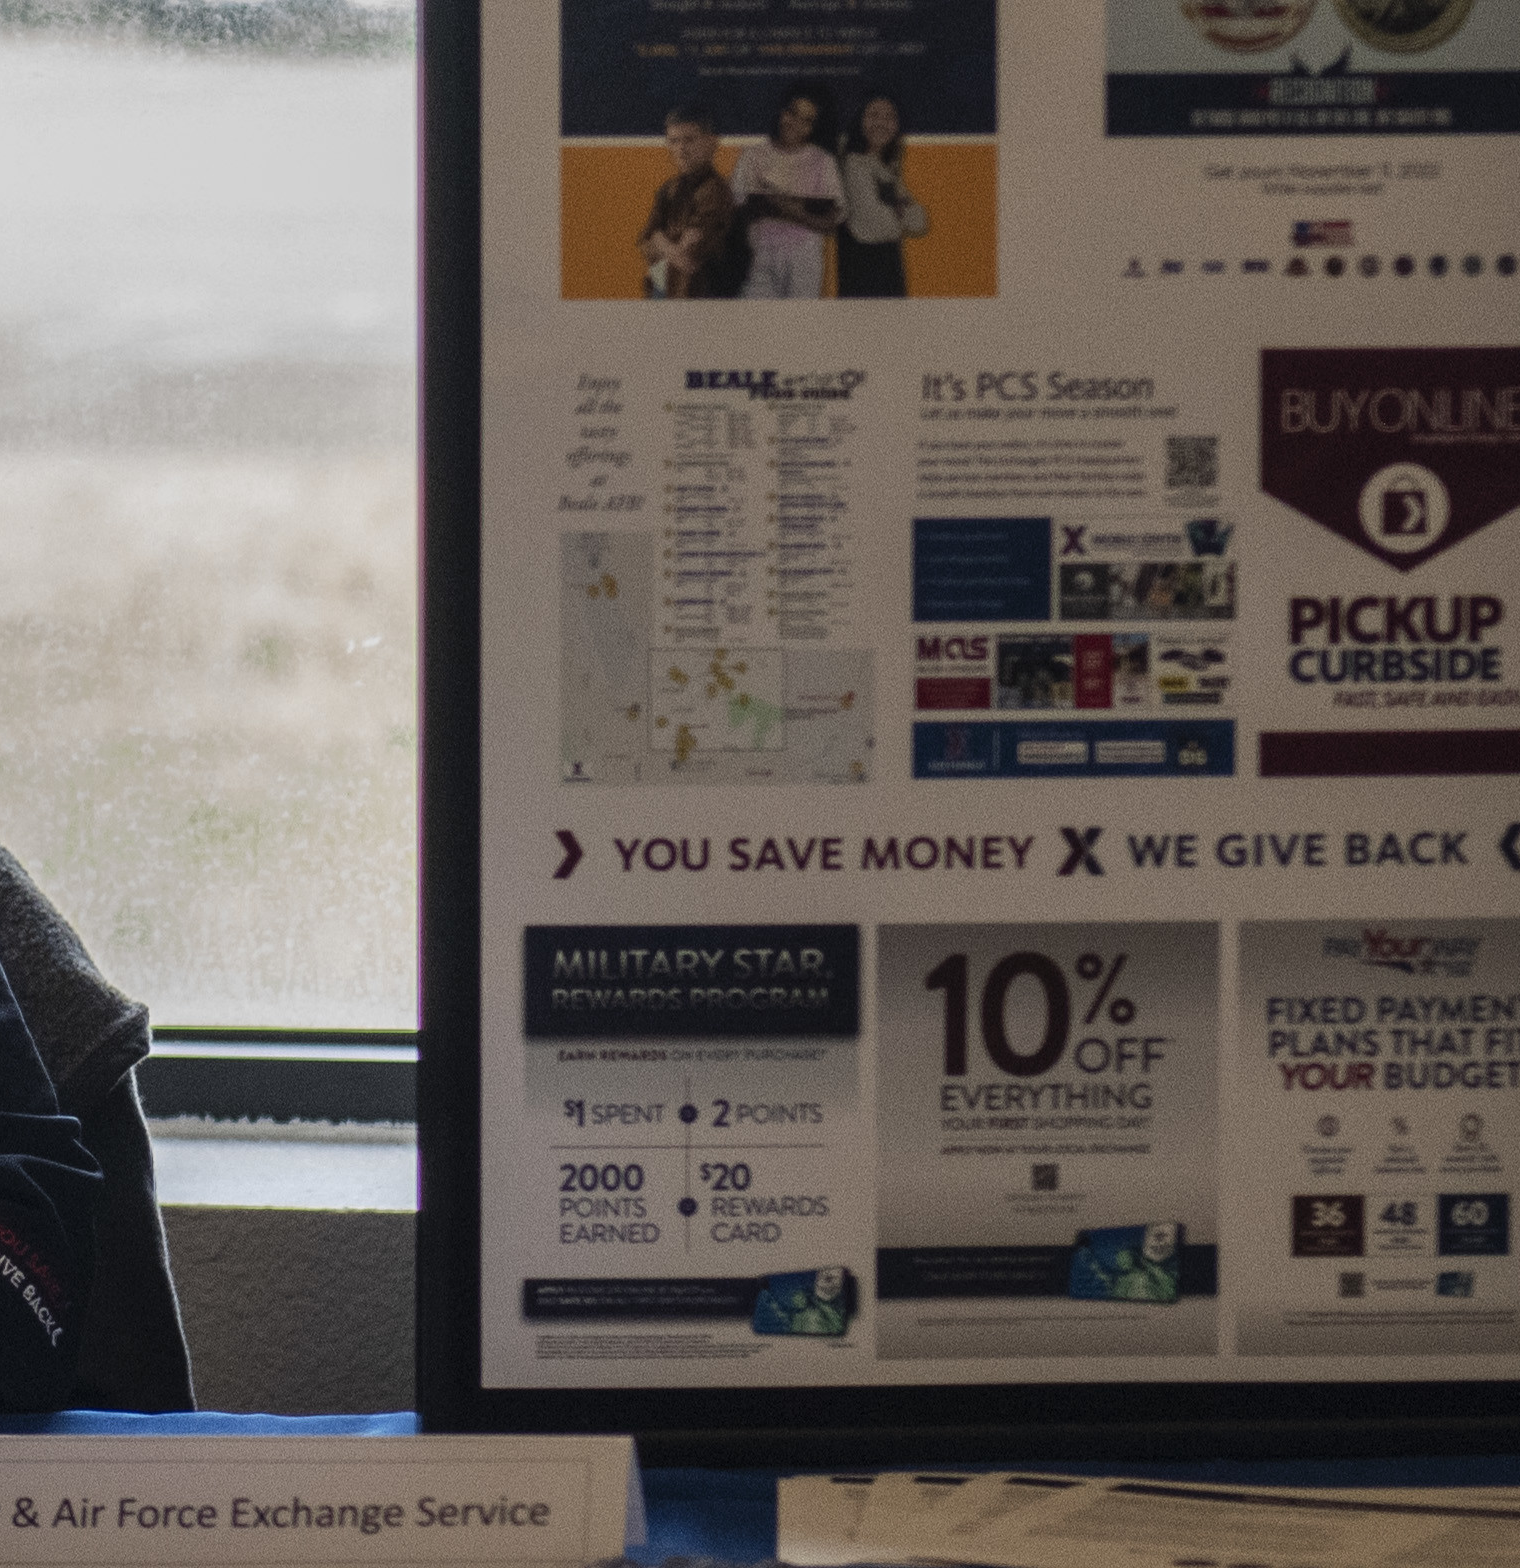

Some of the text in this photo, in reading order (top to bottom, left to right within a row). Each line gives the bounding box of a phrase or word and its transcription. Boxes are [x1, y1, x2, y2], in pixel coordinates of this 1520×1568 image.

[921, 372, 1153, 401] It's PCS Season
[1289, 596, 1504, 645] PICKUP
[1289, 647, 1502, 684] CURBSIDE
[614, 837, 712, 872] YOU
[727, 836, 845, 872] SAVE
[860, 835, 1037, 871] MONEY
[1126, 834, 1198, 869] WE
[1214, 833, 1328, 868] GIVE
[1345, 831, 1469, 866] BACK
[553, 948, 726, 981] MILITARY
[551, 985, 830, 1013] REWARDS PROGRAM
[1266, 997, 1365, 1026] FIXED
[924, 951, 1138, 1078] 10%
[1268, 1030, 1380, 1058] PLANS
[1391, 1029, 1474, 1057] THAT
[1279, 1063, 1375, 1091] YOUR
[940, 1082, 1154, 1113] EVERYTHING
[563, 1098, 824, 1128] $1 SPENT 2 POINTS
[559, 1163, 645, 1193] 2000
[700, 1162, 753, 1192] $20
[559, 1197, 648, 1219] POINTS
[711, 1196, 830, 1217] REWARDS
[1311, 1201, 1347, 1228] 36
[1380, 1200, 1419, 1228] 48
[1450, 1200, 1490, 1227] 60
[559, 1223, 662, 1245] EARNED
[710, 1222, 783, 1244] CARD
[22, 1283, 57, 1336] BACK
[11, 1498, 41, 1529] &
[52, 1498, 106, 1529] Air
[117, 1497, 218, 1529] Force
[231, 1496, 405, 1534] Exchange
[416, 1495, 552, 1529] Service
